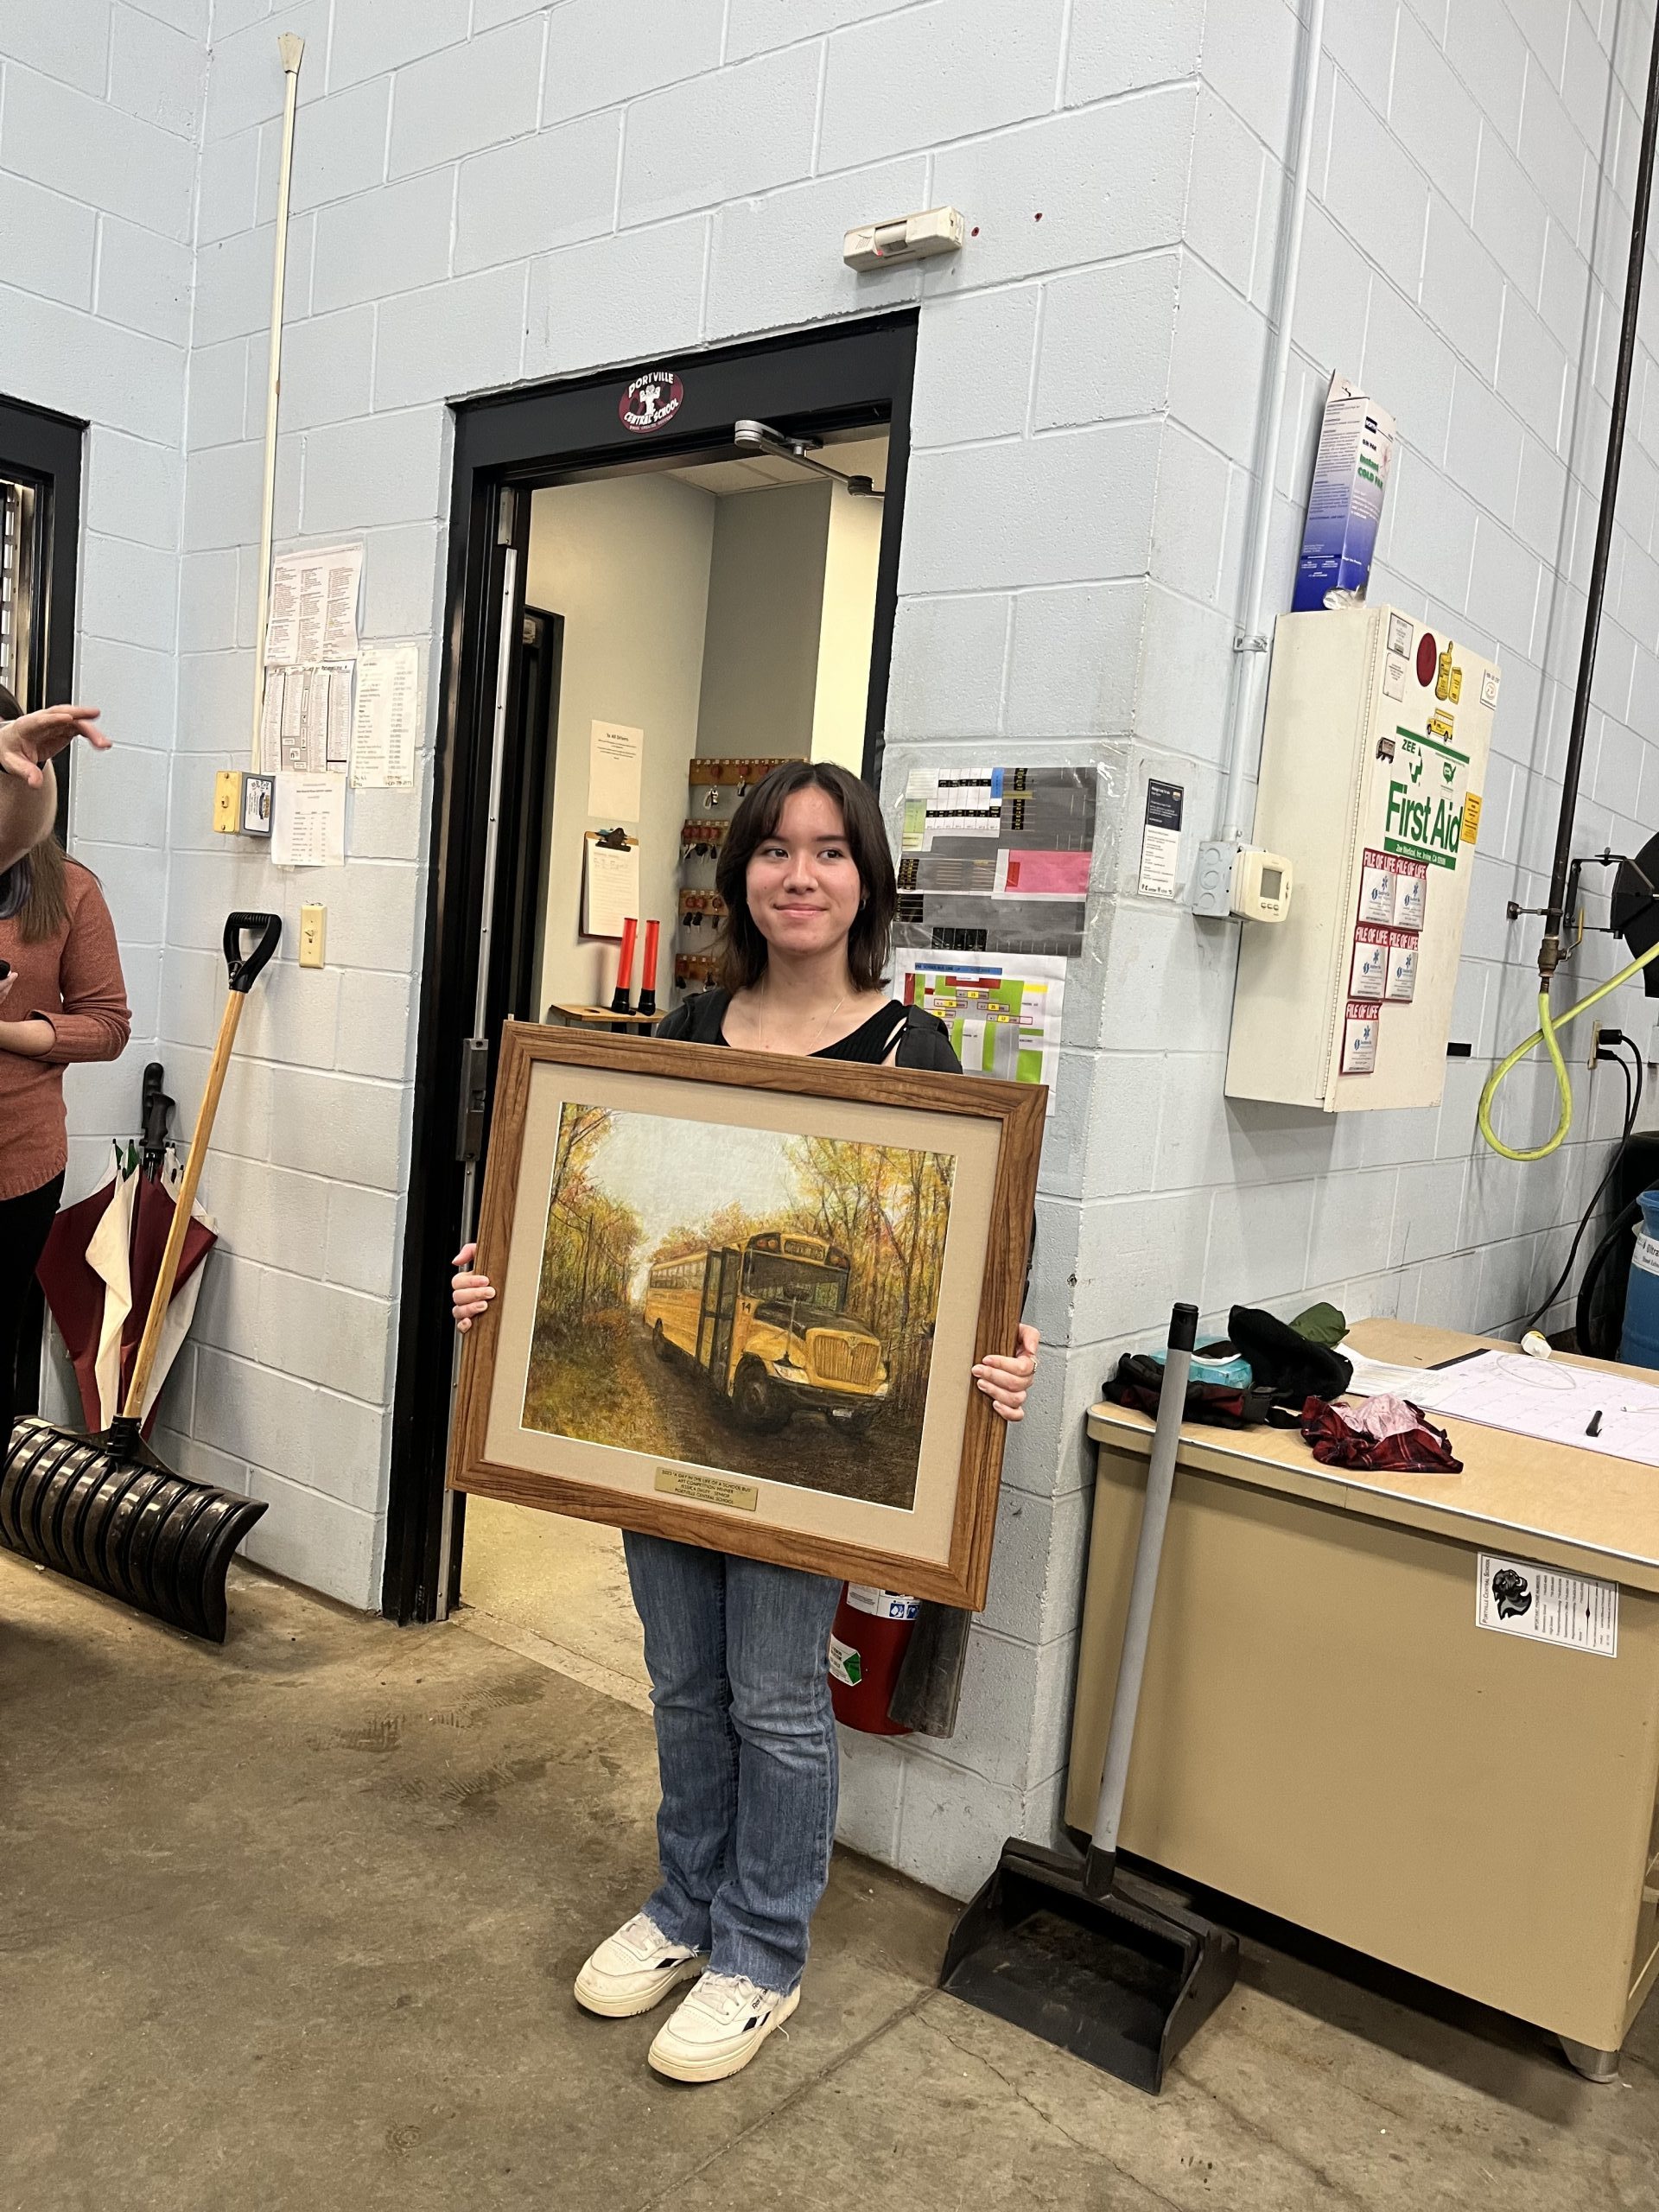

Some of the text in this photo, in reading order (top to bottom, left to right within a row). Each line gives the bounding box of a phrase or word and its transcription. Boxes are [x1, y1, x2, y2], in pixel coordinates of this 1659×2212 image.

[628, 372, 674, 398] PORTVILLE
[624, 411, 652, 425] CENTRAL
[653, 398, 679, 422] SCHOOL
[1357, 467, 1374, 483] COLD
[1402, 739, 1416, 754] ZEE
[1386, 780, 1431, 844] First
[1431, 797, 1464, 854] Aid
[1363, 851, 1396, 873] FILE OF LIFE
[1395, 859, 1427, 879] FILE OF LIFE
[1356, 927, 1389, 944] FILE OF LIFE
[1389, 932, 1419, 950] FILE OF LIFE
[1346, 1003, 1378, 1020] FILE OF LIFE
[741, 1301, 751, 1313] 14
